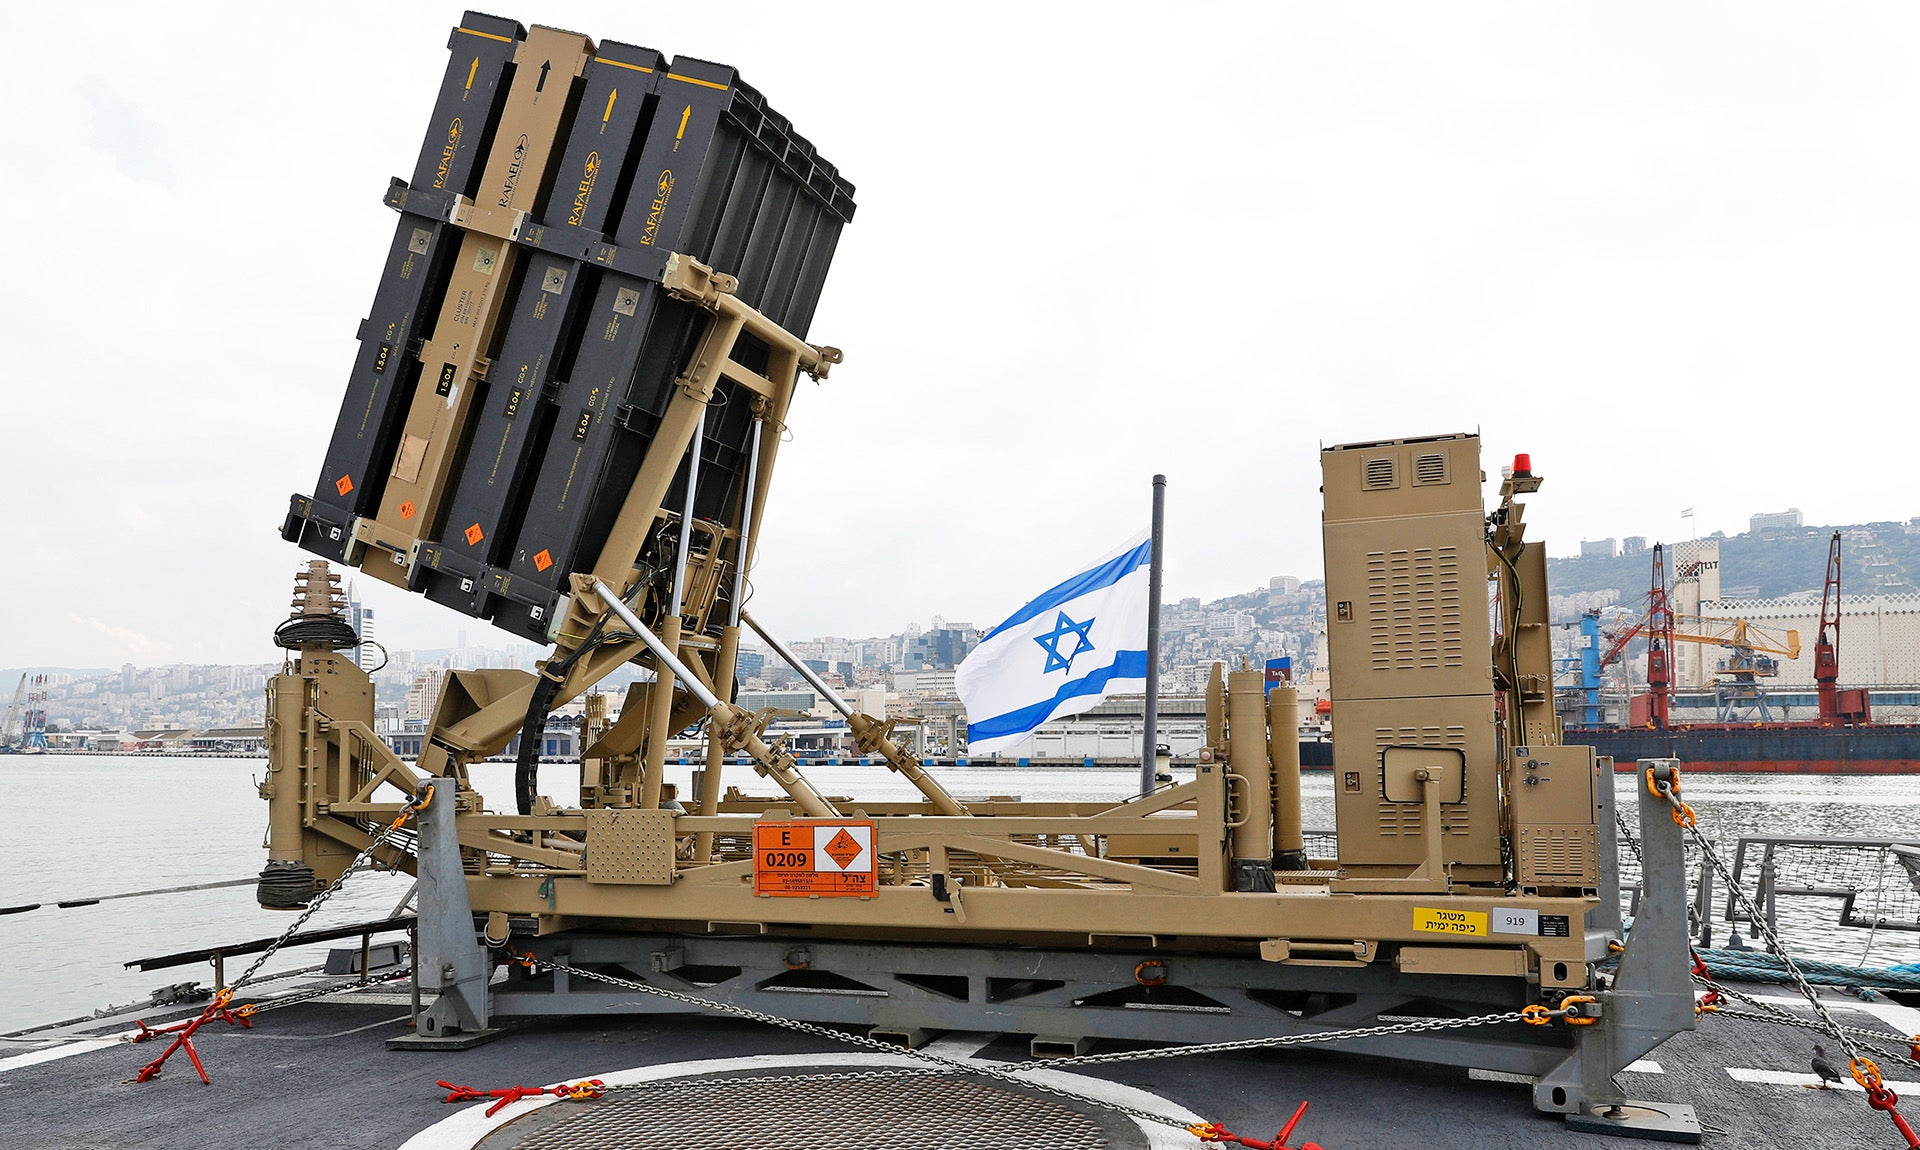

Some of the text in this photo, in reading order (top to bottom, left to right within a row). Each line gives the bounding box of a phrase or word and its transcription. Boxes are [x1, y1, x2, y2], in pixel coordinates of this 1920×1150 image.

[432, 140, 454, 188] RAFAEL
[497, 157, 521, 208] RAFAEL
[567, 175, 591, 226] RAFAEL
[639, 193, 664, 245] RAFAEL
[453, 289, 467, 322] CLUSTER
[384, 328, 393, 341] CG
[376, 346, 389, 371] 15.04
[440, 367, 453, 392] 15.04
[517, 372, 525, 384] CG
[507, 390, 521, 416] 15.04
[587, 394, 596, 407] CG
[576, 413, 590, 439] 15.04
[782, 831, 790, 846] E
[766, 853, 807, 867] 0209
[842, 873, 866, 883] צה"ל
[1436, 911, 1466, 922] משגר
[1506, 916, 1525, 926] 919
[1425, 921, 1476, 933] כיפה ימית
